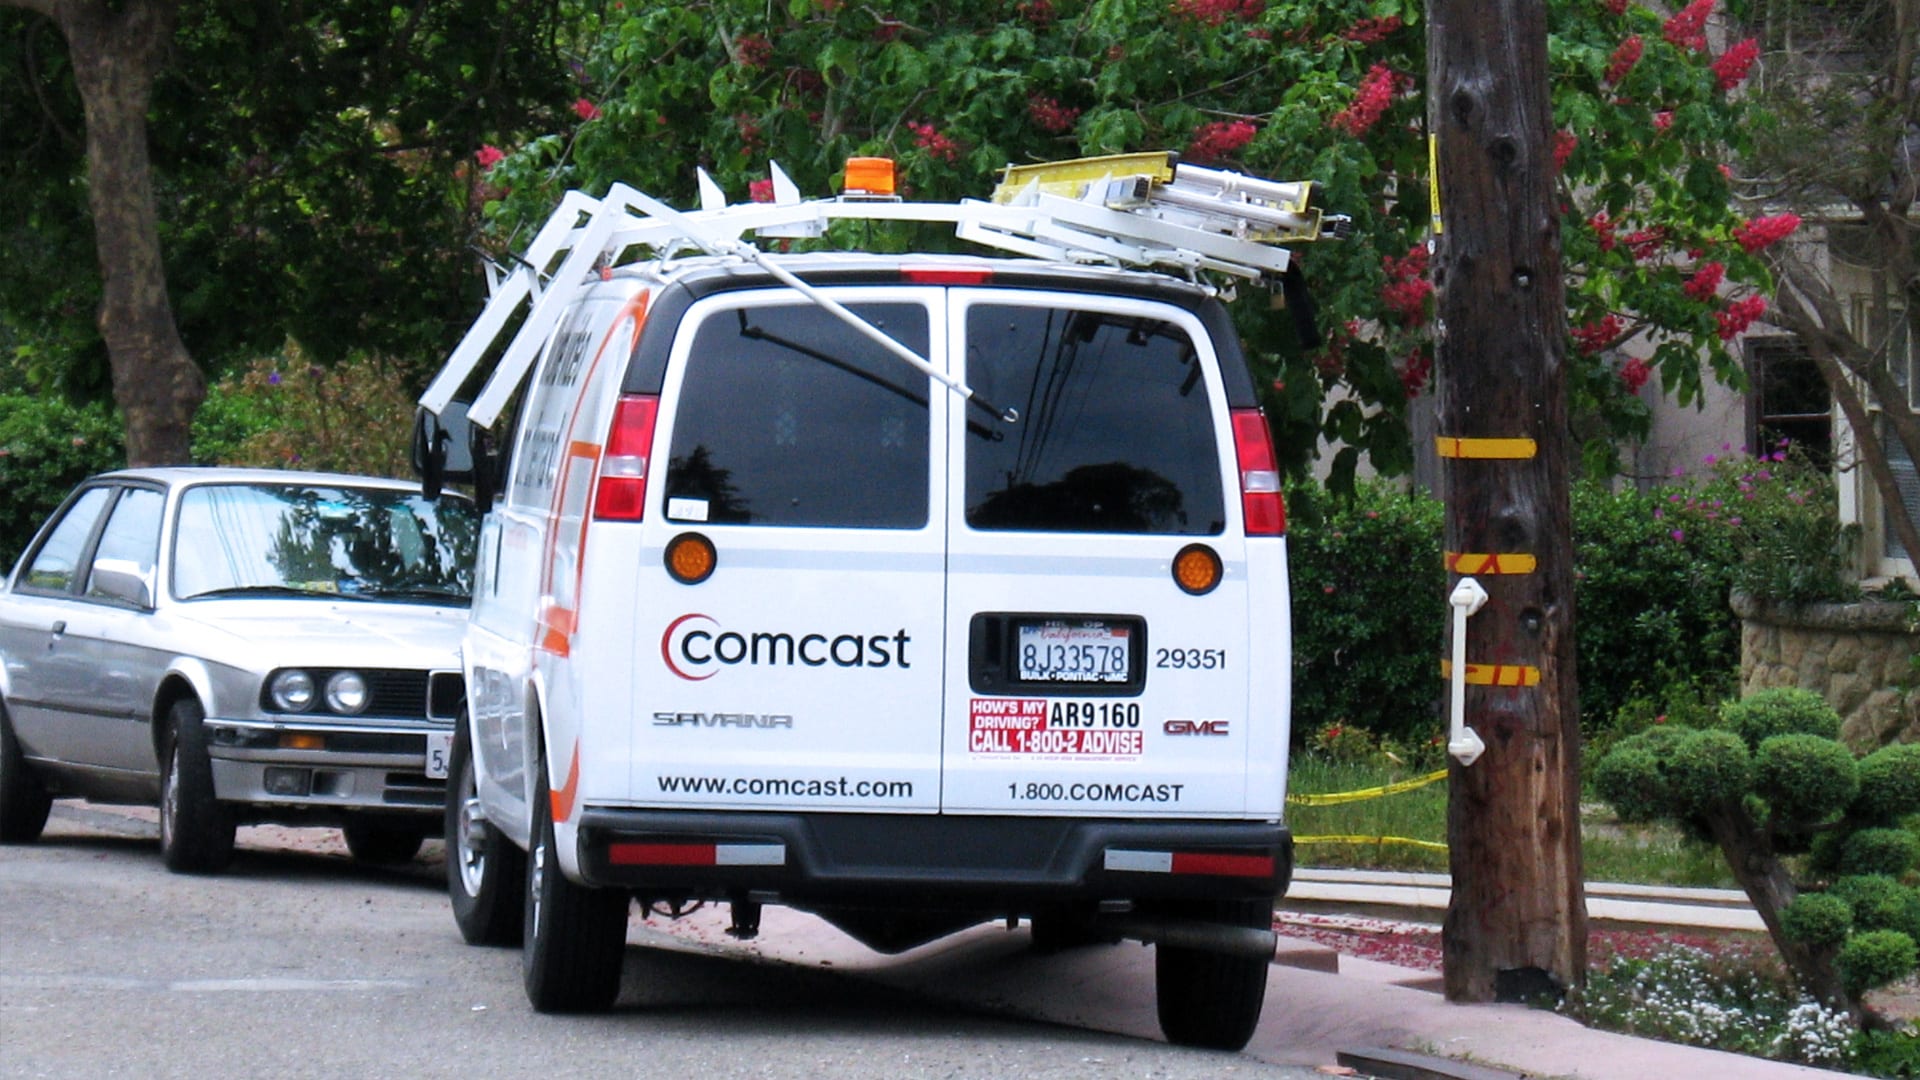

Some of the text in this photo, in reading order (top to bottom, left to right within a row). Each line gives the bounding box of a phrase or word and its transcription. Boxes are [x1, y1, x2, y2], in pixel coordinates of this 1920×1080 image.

[680, 628, 911, 668] comcast
[1023, 644, 1125, 672] 8J33578
[1156, 648, 1226, 669] 29351
[972, 701, 1045, 714] HOW'S MY
[1050, 702, 1140, 727] AR9160
[652, 711, 793, 728] SAVANA
[975, 716, 1038, 729] DRIVING?
[1163, 719, 1229, 736] GMC
[971, 730, 1141, 753] CALL 1-800-2 ADVISE
[657, 776, 913, 798] www.comcast.com
[1008, 783, 1184, 802] 1.800.COMCAST
